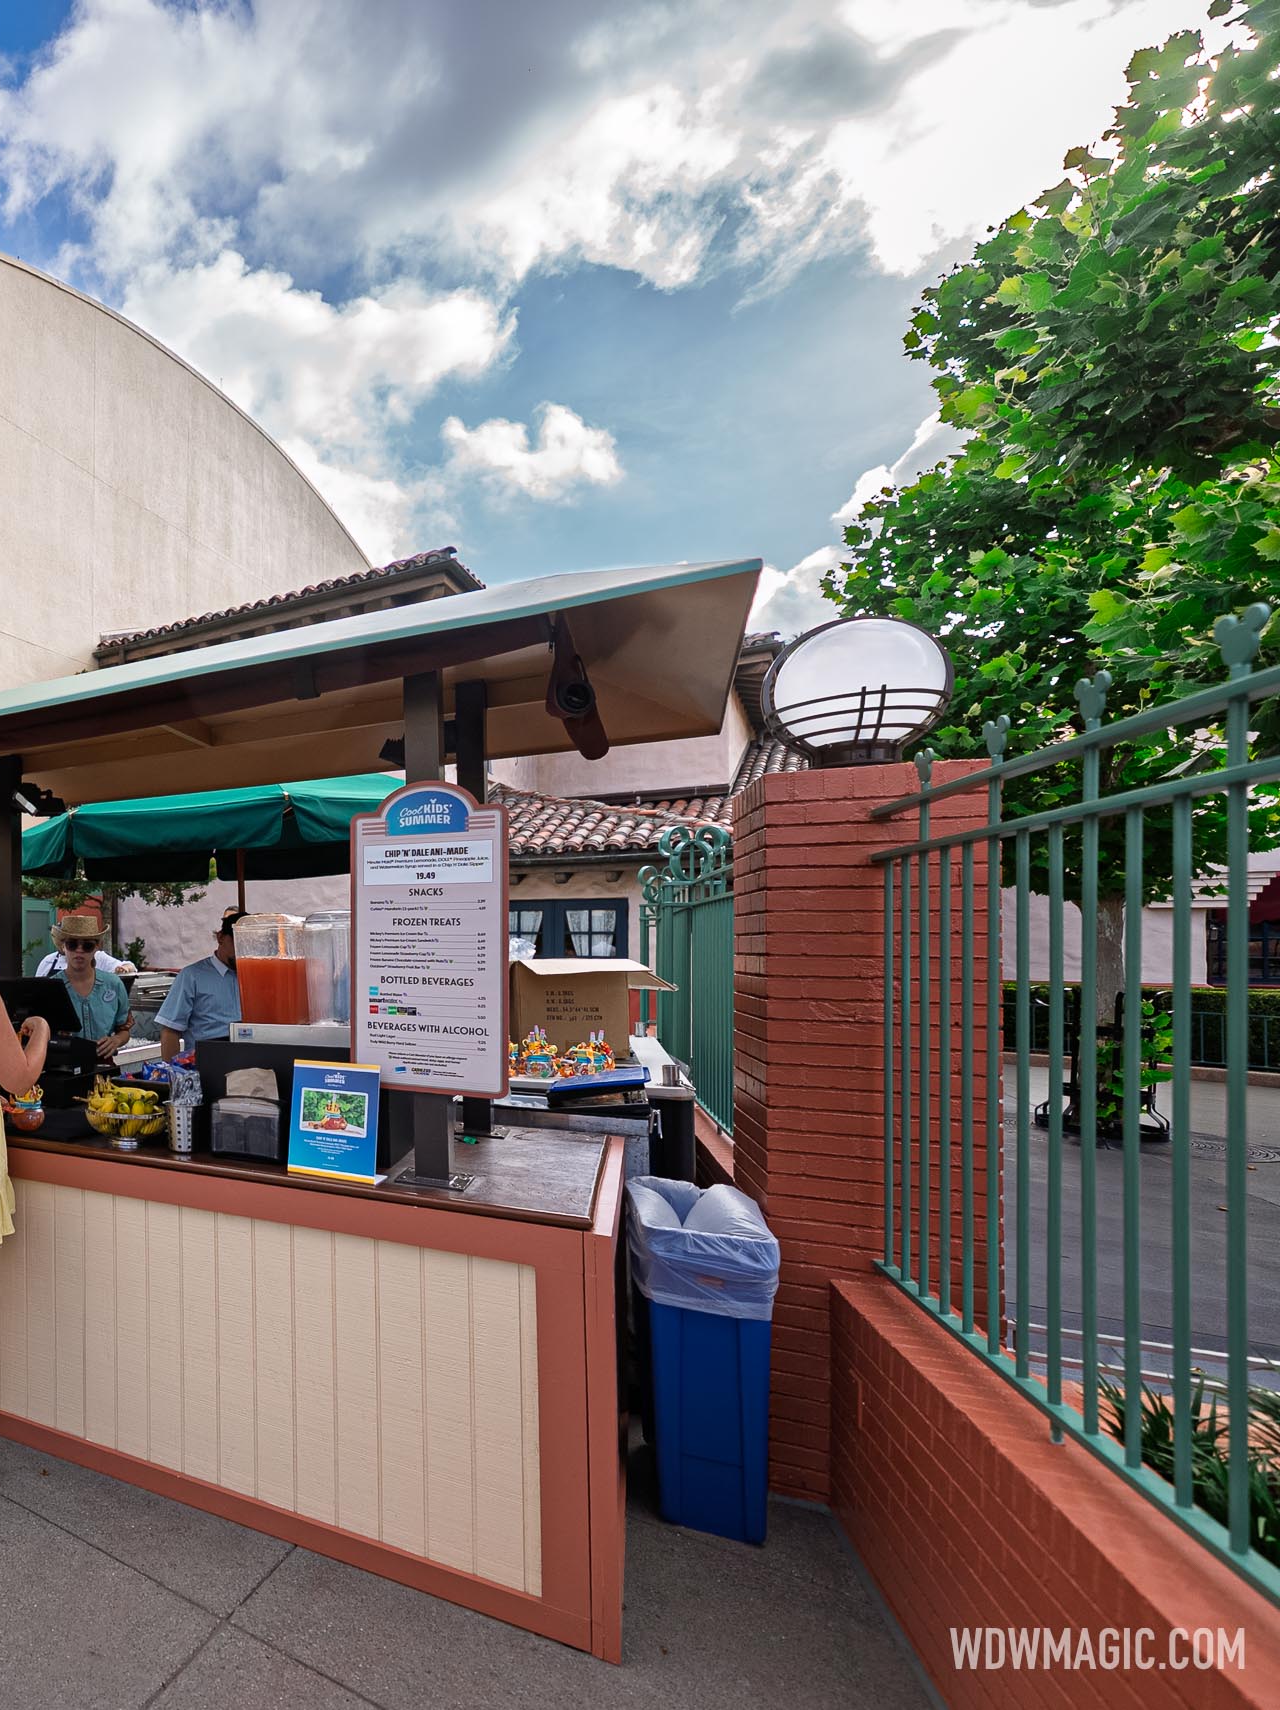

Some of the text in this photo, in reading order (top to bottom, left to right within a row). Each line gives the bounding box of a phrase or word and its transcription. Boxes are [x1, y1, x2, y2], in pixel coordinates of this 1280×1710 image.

[400, 806, 424, 818] Cool
[400, 814, 450, 828] SUMMER
[385, 850, 400, 858] CHIP
[412, 848, 429, 857] DALE
[430, 847, 468, 856] ANI-MADE
[416, 872, 436, 880] 19.49
[409, 888, 443, 896] SNACKS
[393, 918, 461, 926] FROZEN TREATS
[381, 976, 474, 986] BOTTLED BEVERAGES
[368, 1022, 490, 1036] BEVERAGES WITH ALCOHOL
